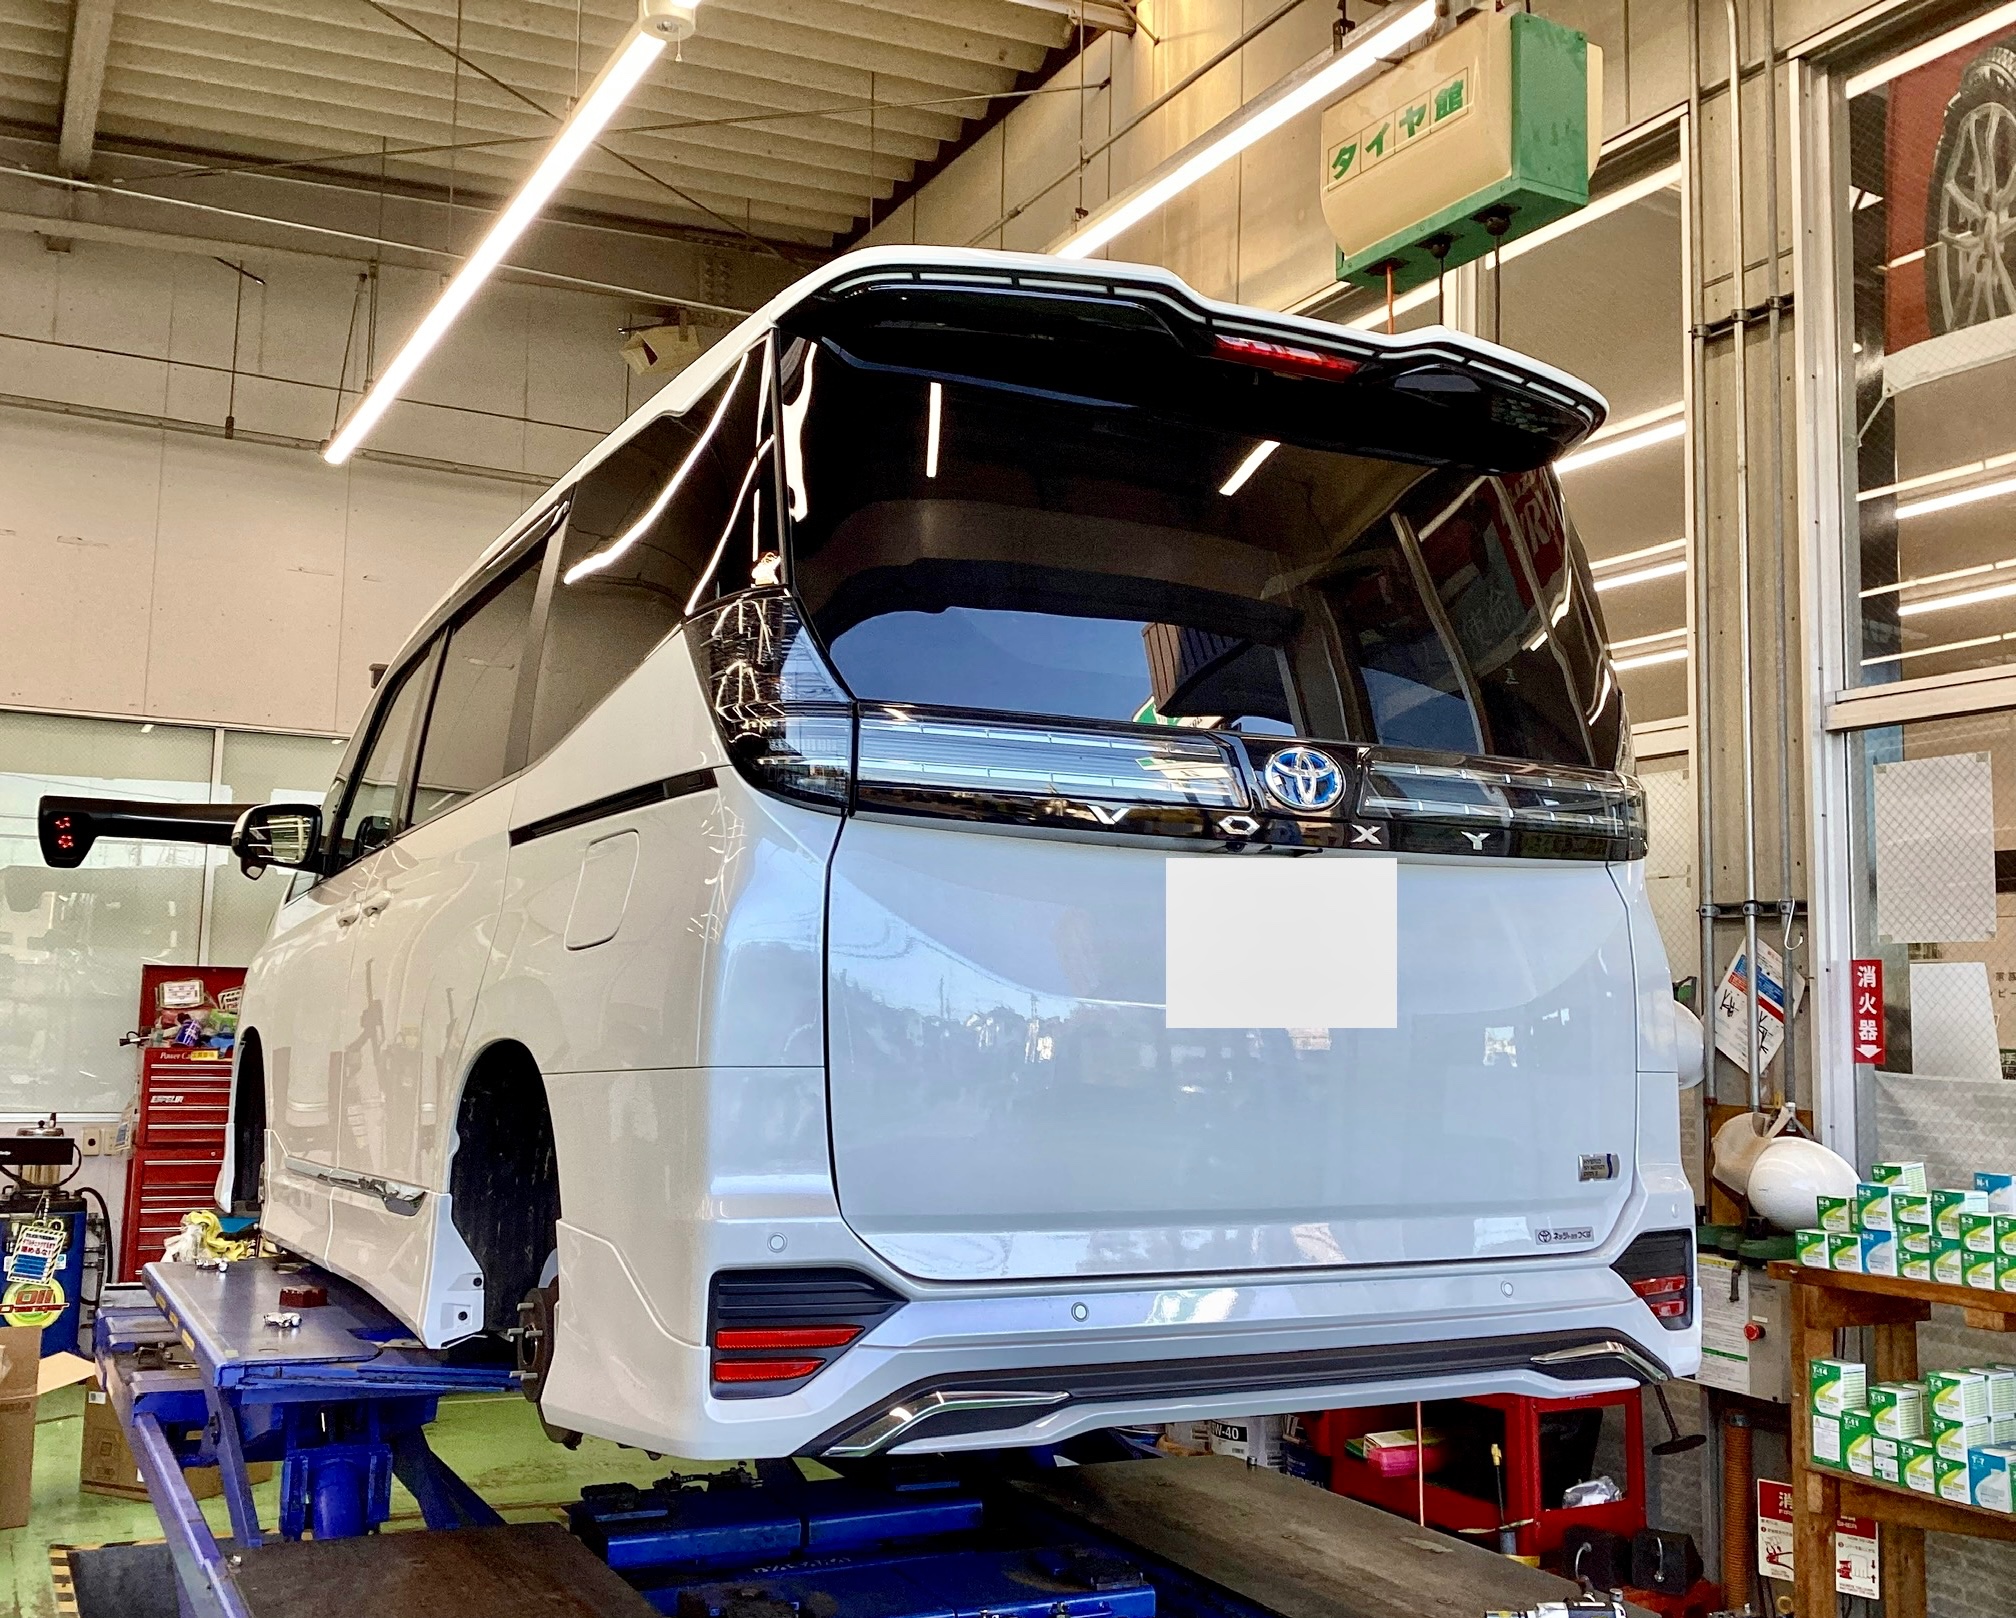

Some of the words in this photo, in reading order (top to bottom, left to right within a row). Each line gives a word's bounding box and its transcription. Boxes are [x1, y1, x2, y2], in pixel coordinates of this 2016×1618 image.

[1331, 78, 1464, 181] タイヤ館
[1087, 805, 1491, 851] VOXY
[1856, 965, 1878, 1041] 消火器
[1813, 1366, 1828, 1376] T-14
[1972, 1456, 1985, 1466] T-7
